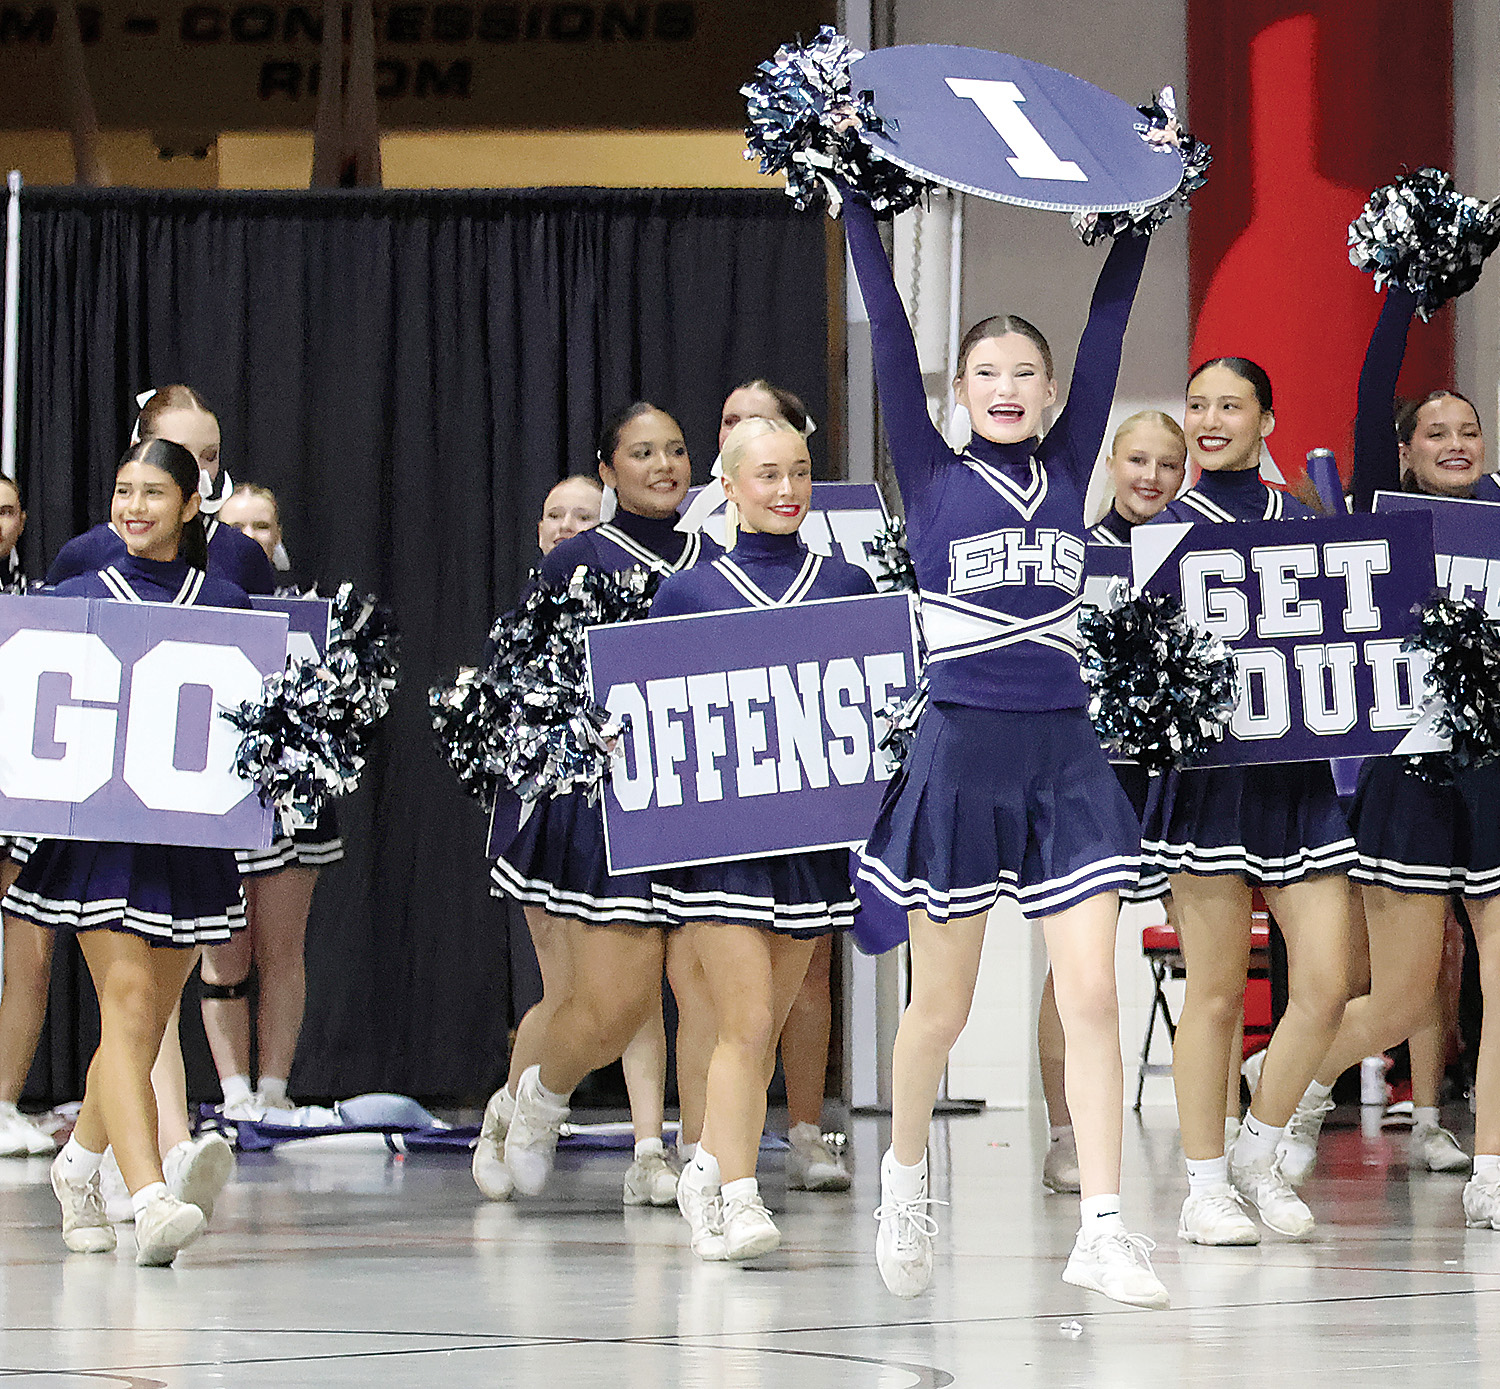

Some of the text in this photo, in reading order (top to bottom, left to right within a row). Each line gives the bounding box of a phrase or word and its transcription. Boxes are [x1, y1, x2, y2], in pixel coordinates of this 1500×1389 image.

[180, 4, 697, 42] CONESSIONS
[945, 77, 1088, 181] I
[948, 528, 1085, 597] EHS
[1179, 539, 1391, 641] GET
[0, 628, 264, 816] GO
[603, 651, 906, 811] OFFENSE
[1217, 638, 1432, 742] OUD
